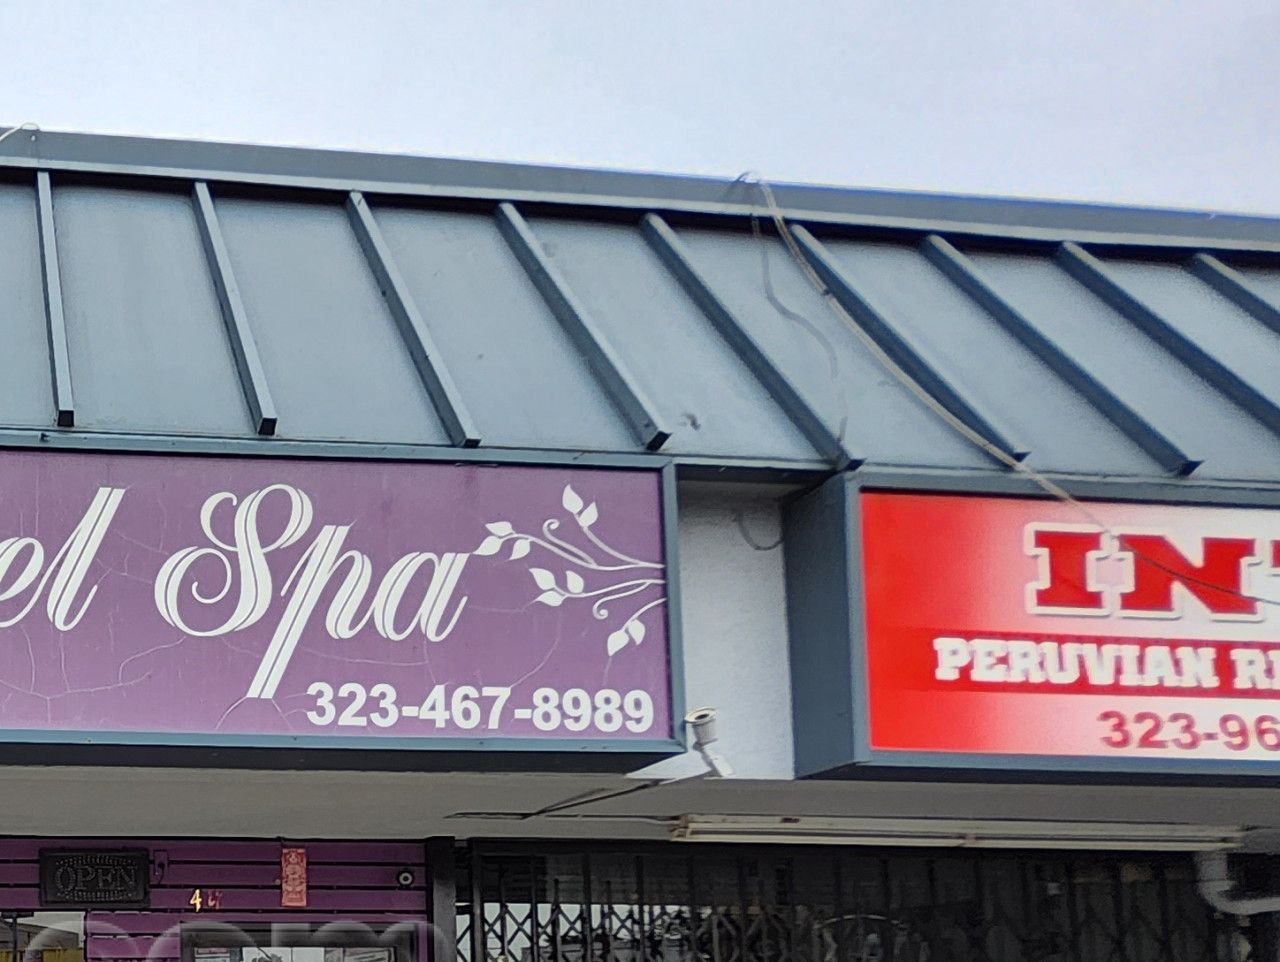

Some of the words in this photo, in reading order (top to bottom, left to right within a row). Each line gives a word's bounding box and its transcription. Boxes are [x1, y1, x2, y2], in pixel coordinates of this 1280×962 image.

[155, 483, 470, 700] Spa
[1024, 522, 1280, 623] IN
[933, 637, 1221, 689] PERUVIAN
[307, 682, 654, 734] 323-467-8989
[1098, 710, 1280, 753] 323-96
[55, 865, 138, 891] OPEN
